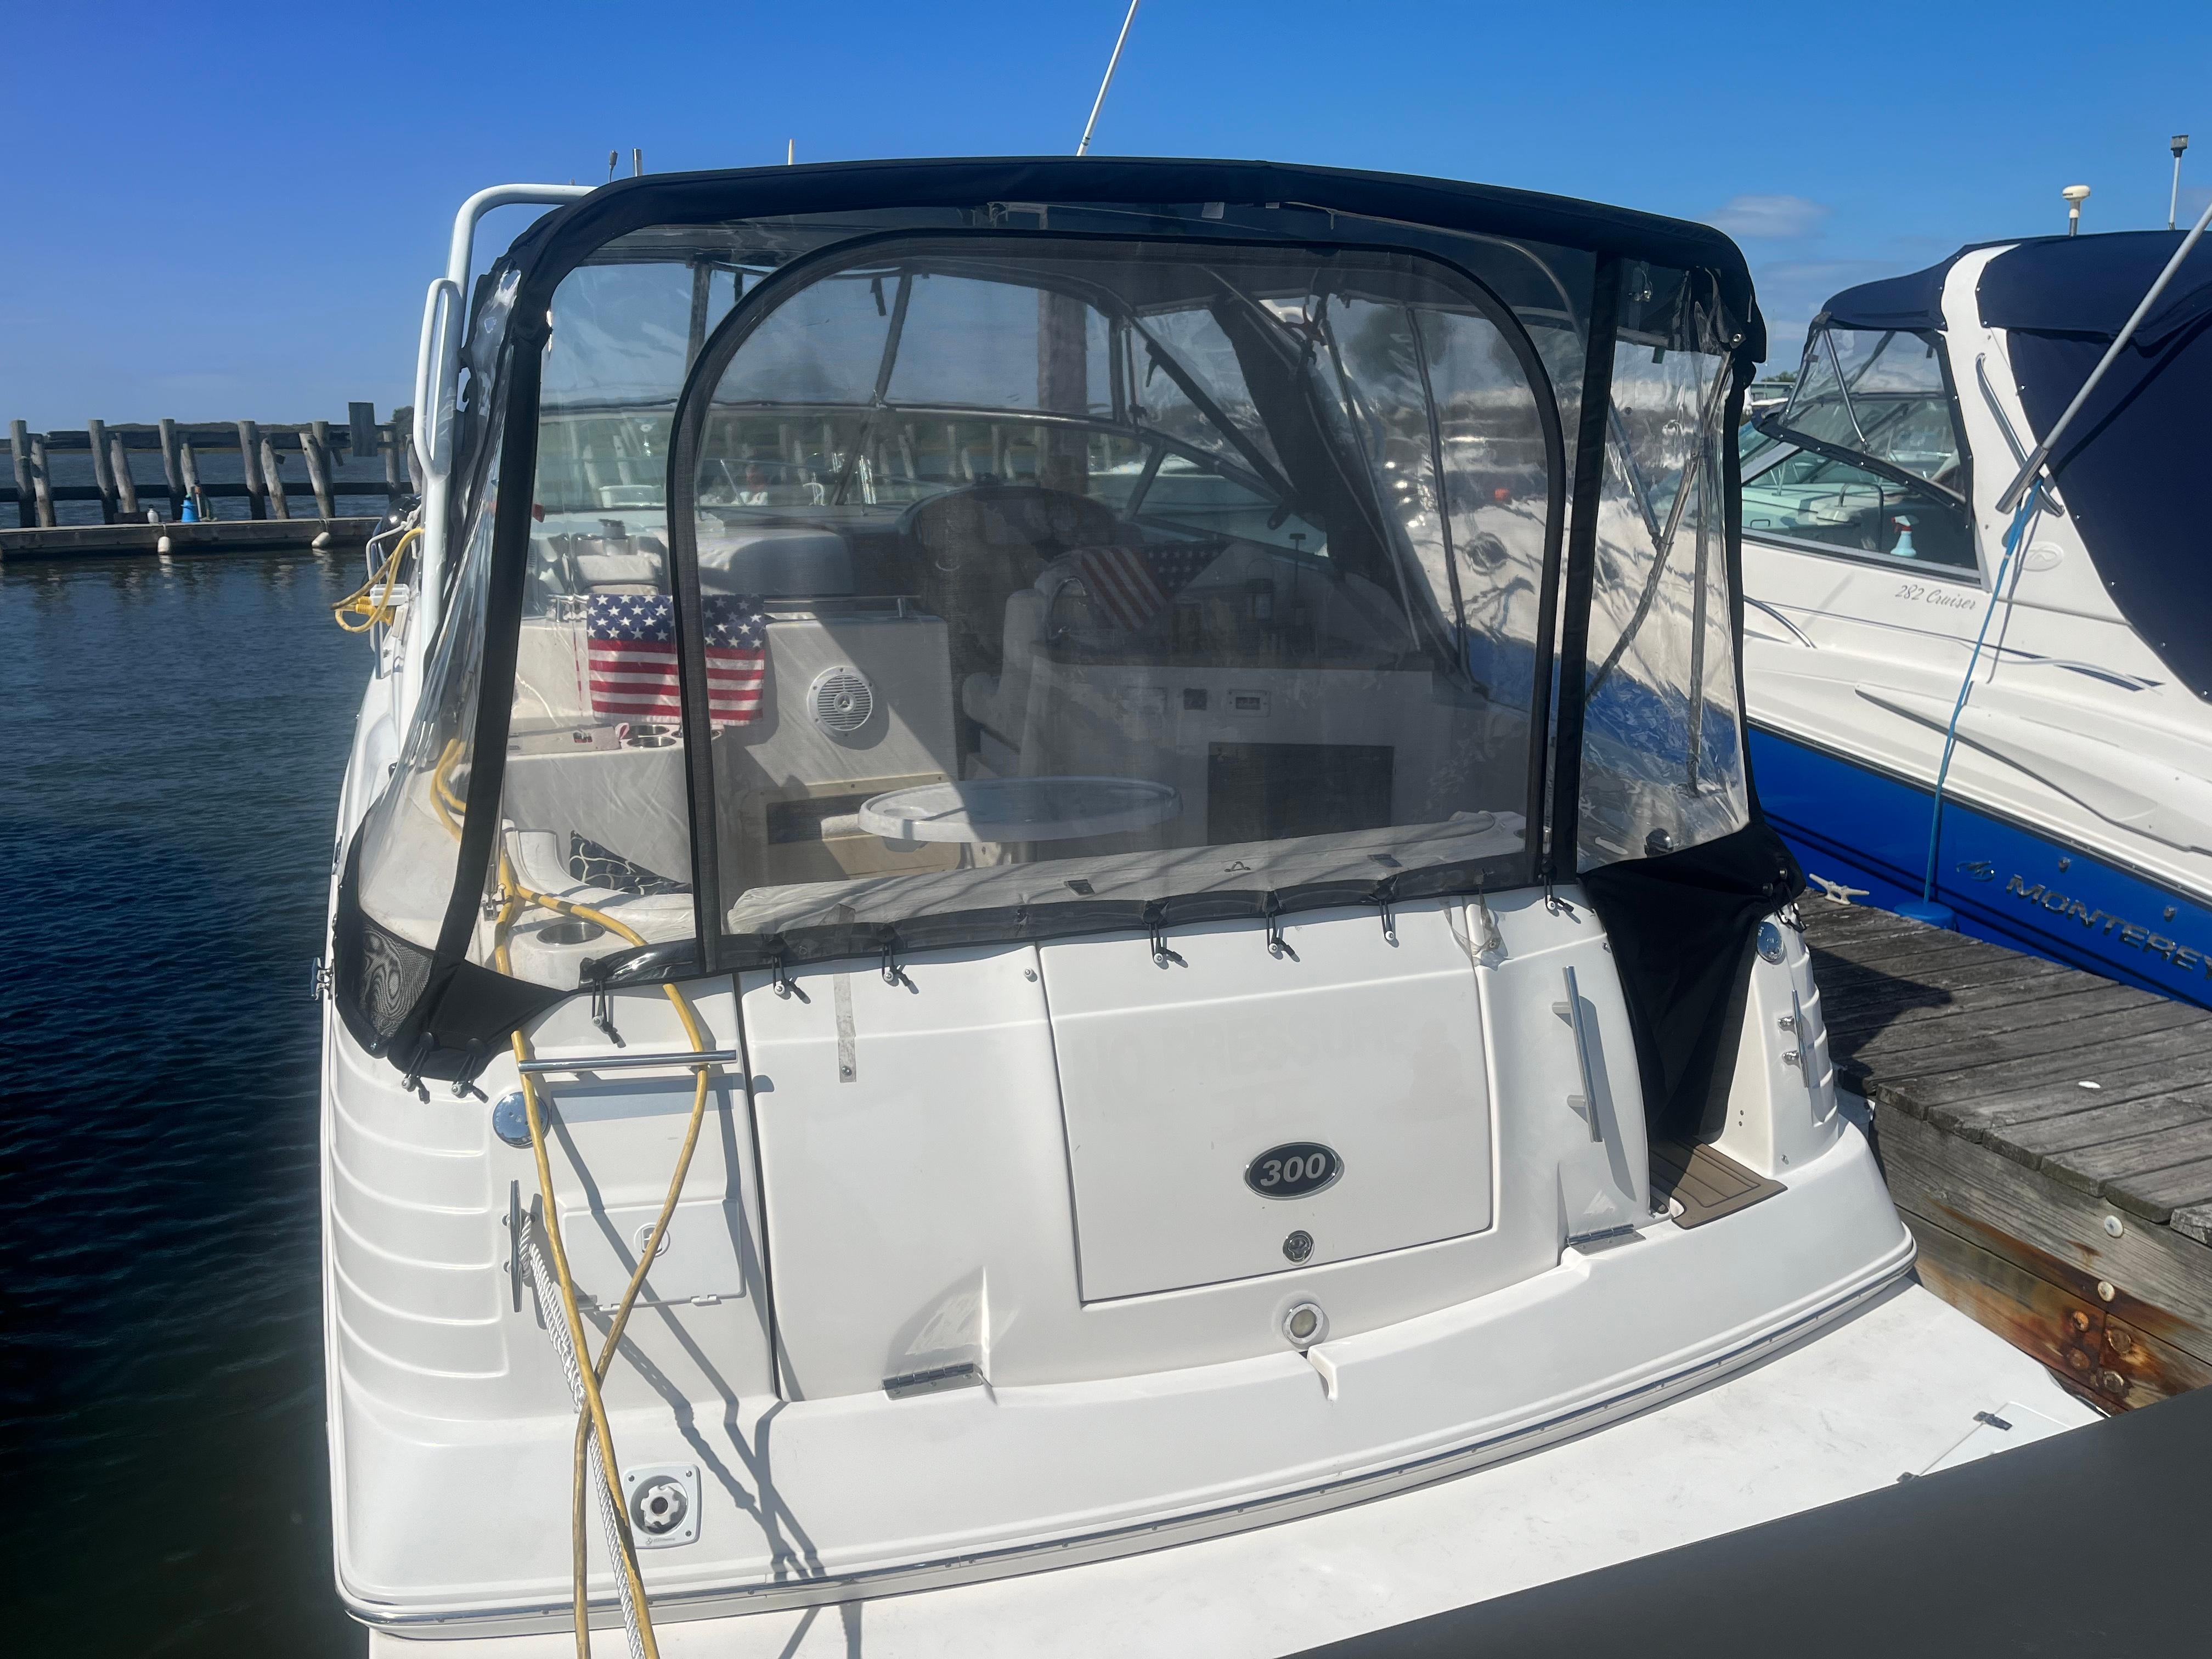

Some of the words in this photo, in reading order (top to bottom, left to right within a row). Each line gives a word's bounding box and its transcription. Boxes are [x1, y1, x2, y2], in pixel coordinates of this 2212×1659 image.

[1895, 584, 1925, 600] 282
[1926, 589, 1976, 611] Cruiser
[1260, 1152, 1326, 1187] 300
